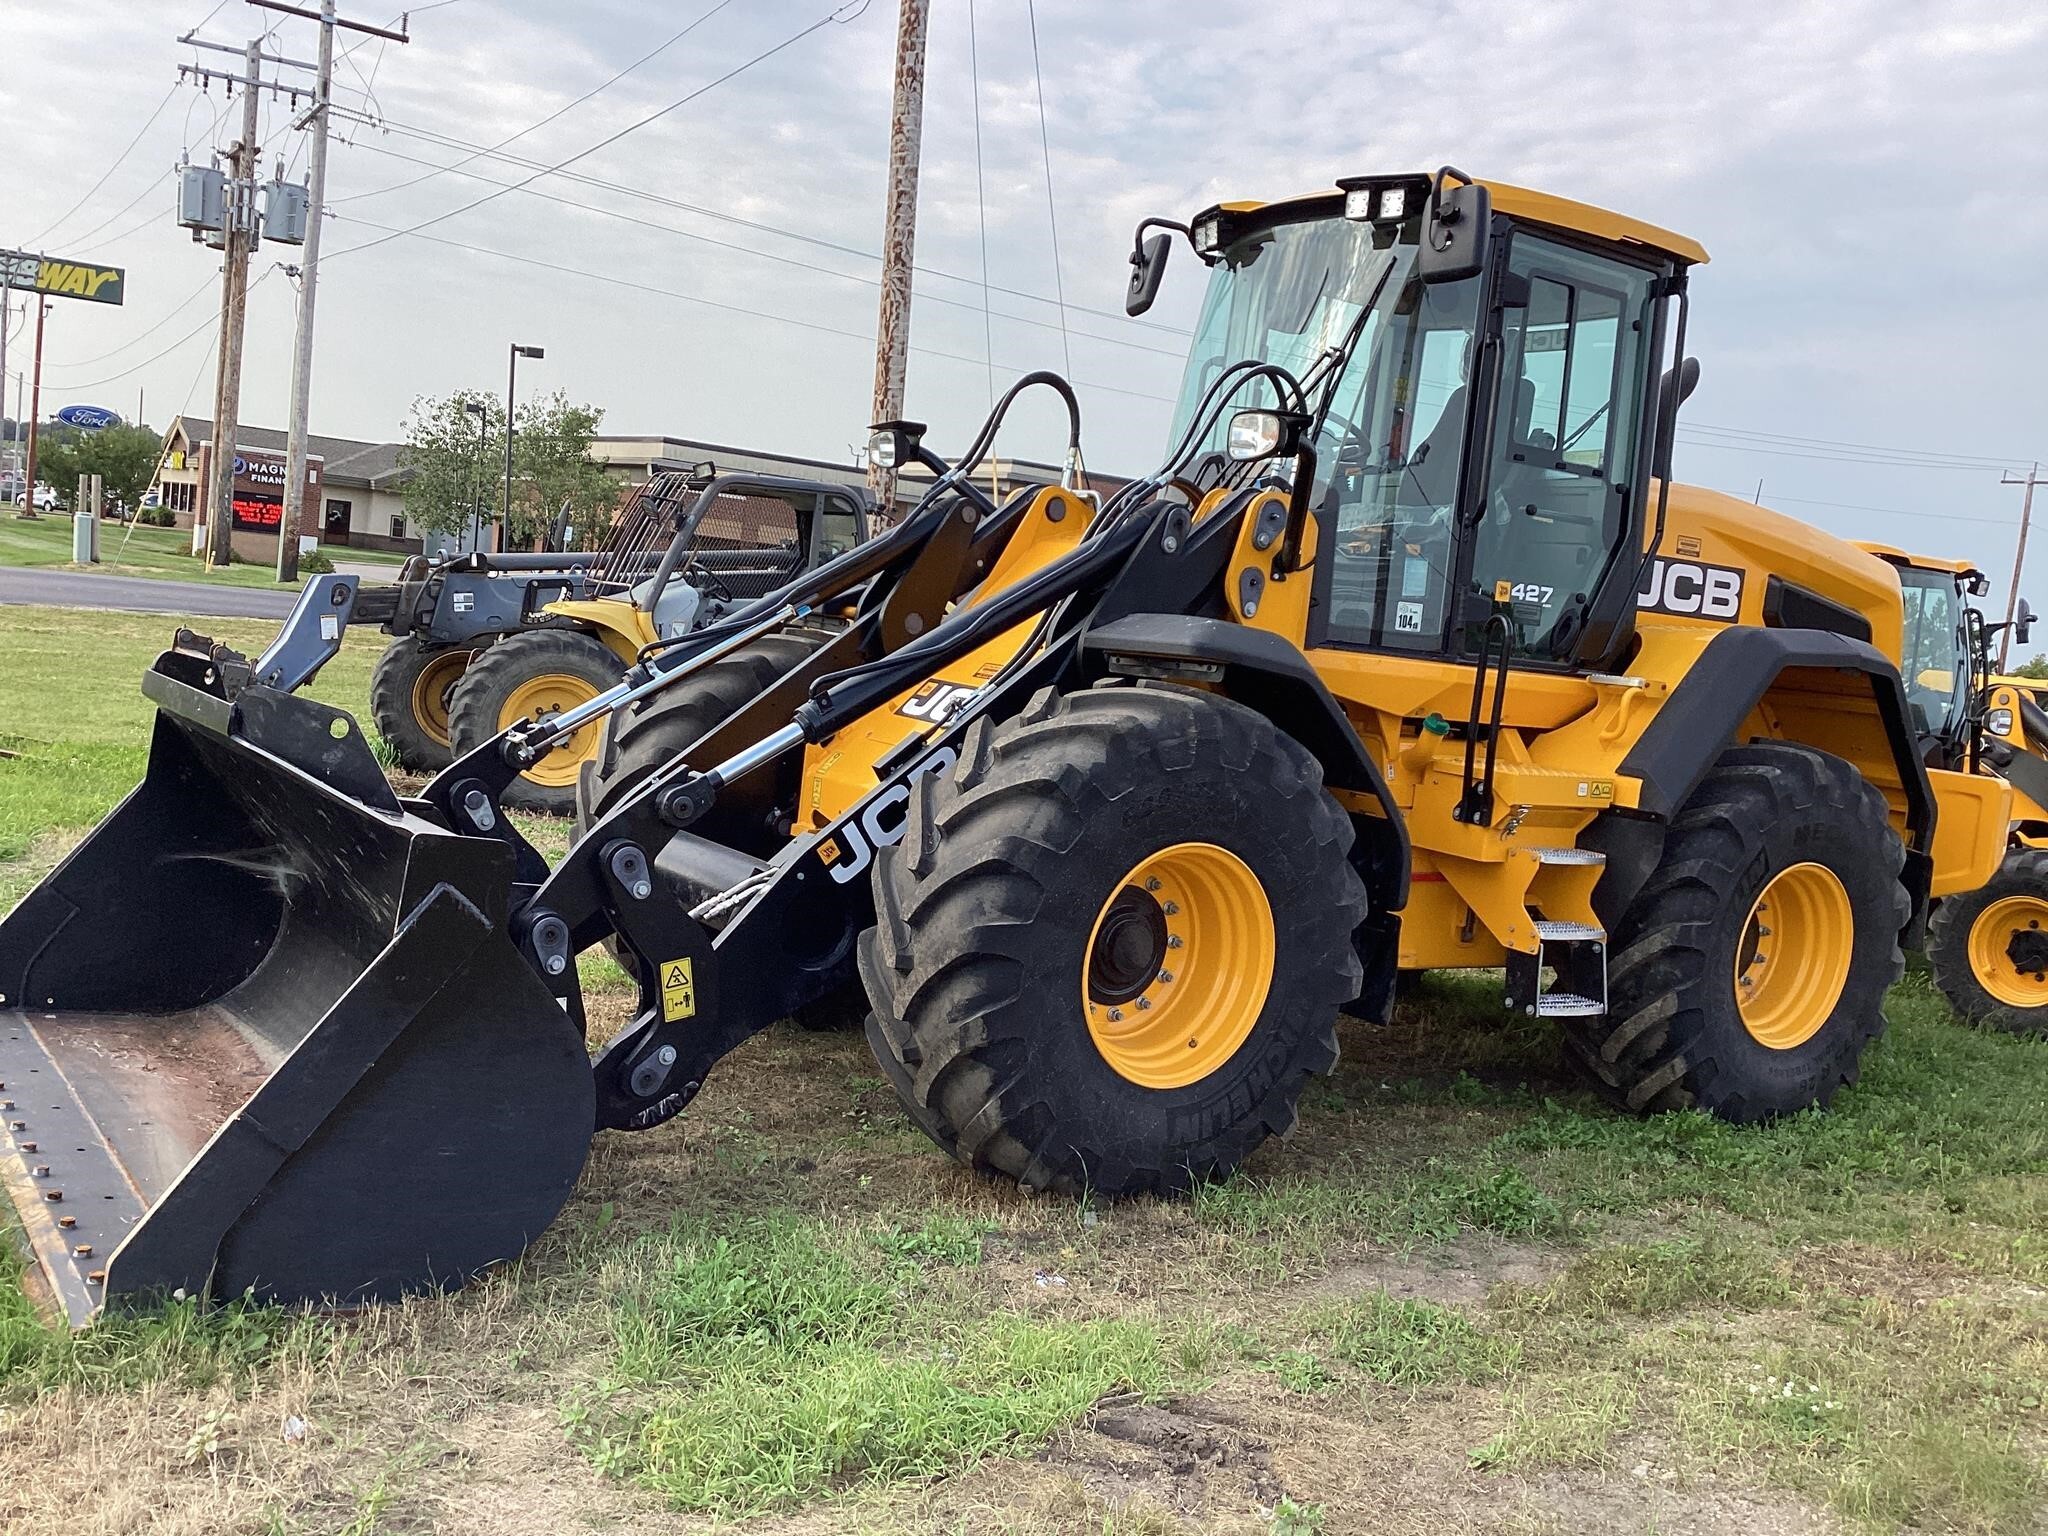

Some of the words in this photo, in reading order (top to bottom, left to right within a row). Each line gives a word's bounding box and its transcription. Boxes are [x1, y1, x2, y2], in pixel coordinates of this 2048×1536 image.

[71, 409, 109, 427] Ford
[1511, 583, 1553, 603] 427
[1637, 560, 1741, 617] JCB
[1398, 614, 1413, 629] 104
